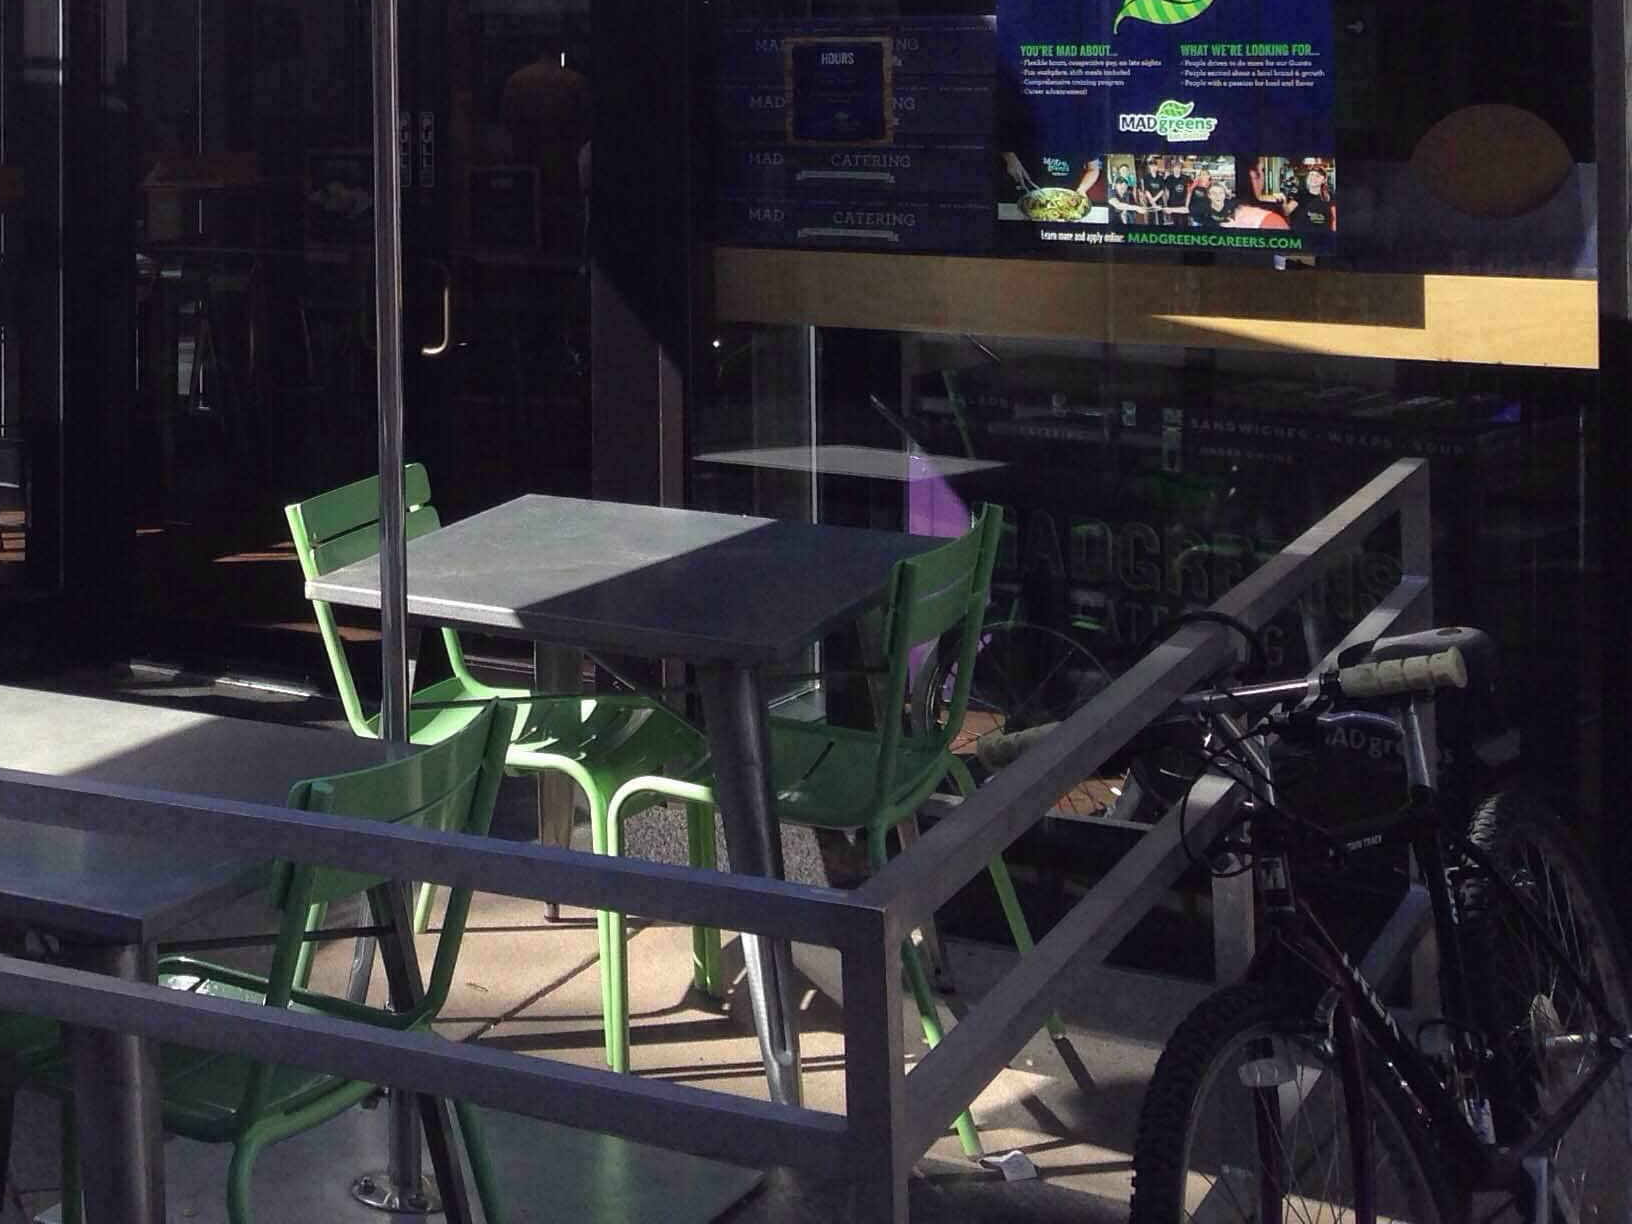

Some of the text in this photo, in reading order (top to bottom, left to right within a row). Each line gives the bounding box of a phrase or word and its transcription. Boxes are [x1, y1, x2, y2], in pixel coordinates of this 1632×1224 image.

[1020, 45, 1053, 57] YOU'RE
[1056, 45, 1077, 57] MAD
[1181, 44, 1208, 56] WHAT
[1211, 44, 1243, 56] WE'RE
[1246, 44, 1289, 56] LOOKING
[821, 51, 856, 65] HOURS
[831, 153, 912, 168] CATERING
[833, 211, 917, 227] CATERING
[1127, 233, 1302, 250] MADGREENSCAREERS.COM
